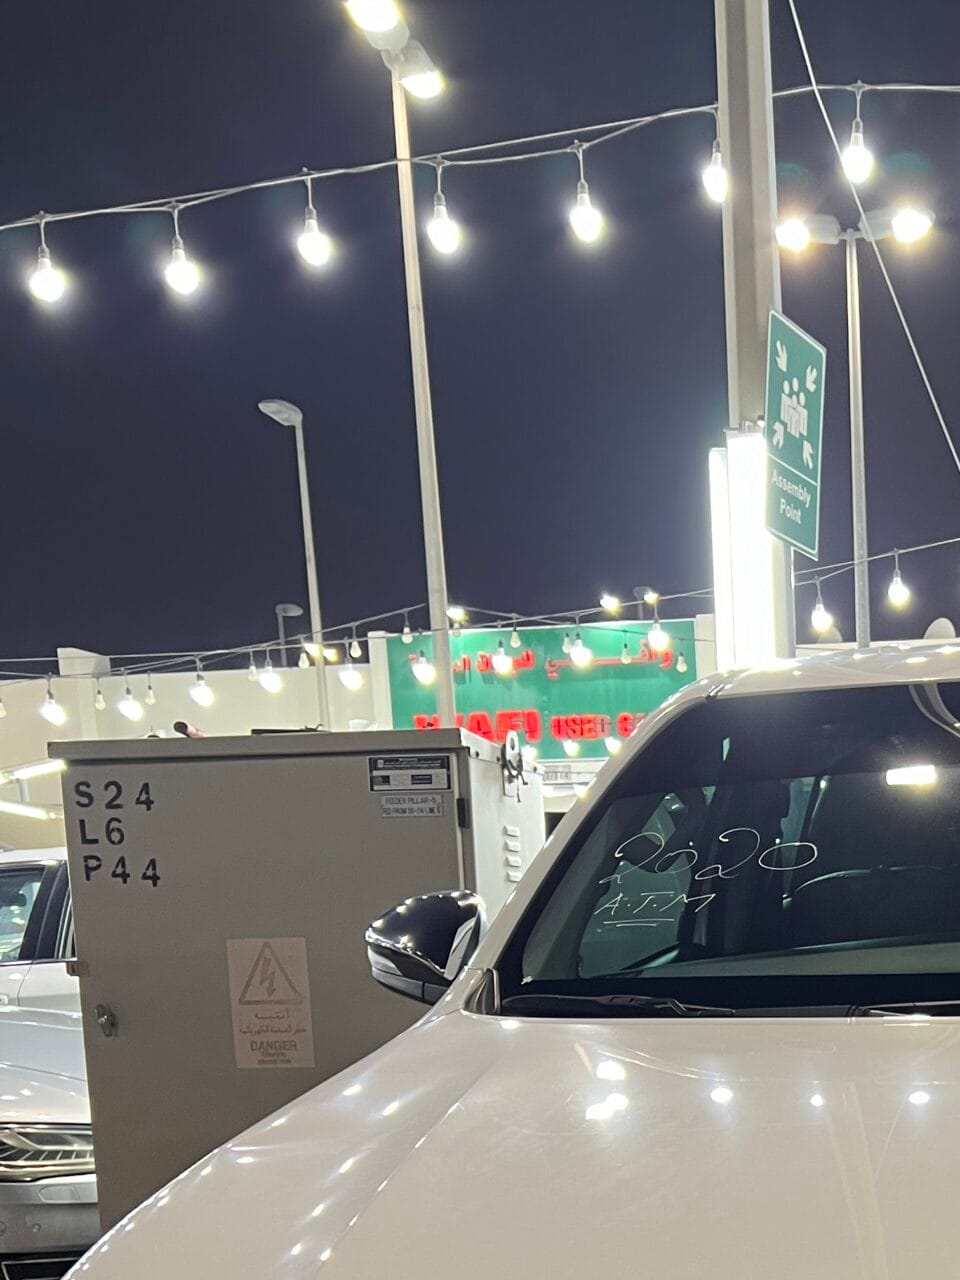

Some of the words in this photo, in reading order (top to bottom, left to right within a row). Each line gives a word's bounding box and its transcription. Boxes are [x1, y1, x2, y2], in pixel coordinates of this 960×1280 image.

[771, 468, 811, 508] Assembly
[780, 497, 802, 525] Point
[551, 714, 611, 740] USED
[74, 780, 155, 812] S24
[79, 817, 125, 846] L6
[598, 826, 818, 885] 2020
[83, 855, 161, 888] P44
[250, 1040, 299, 1053] DANGER
